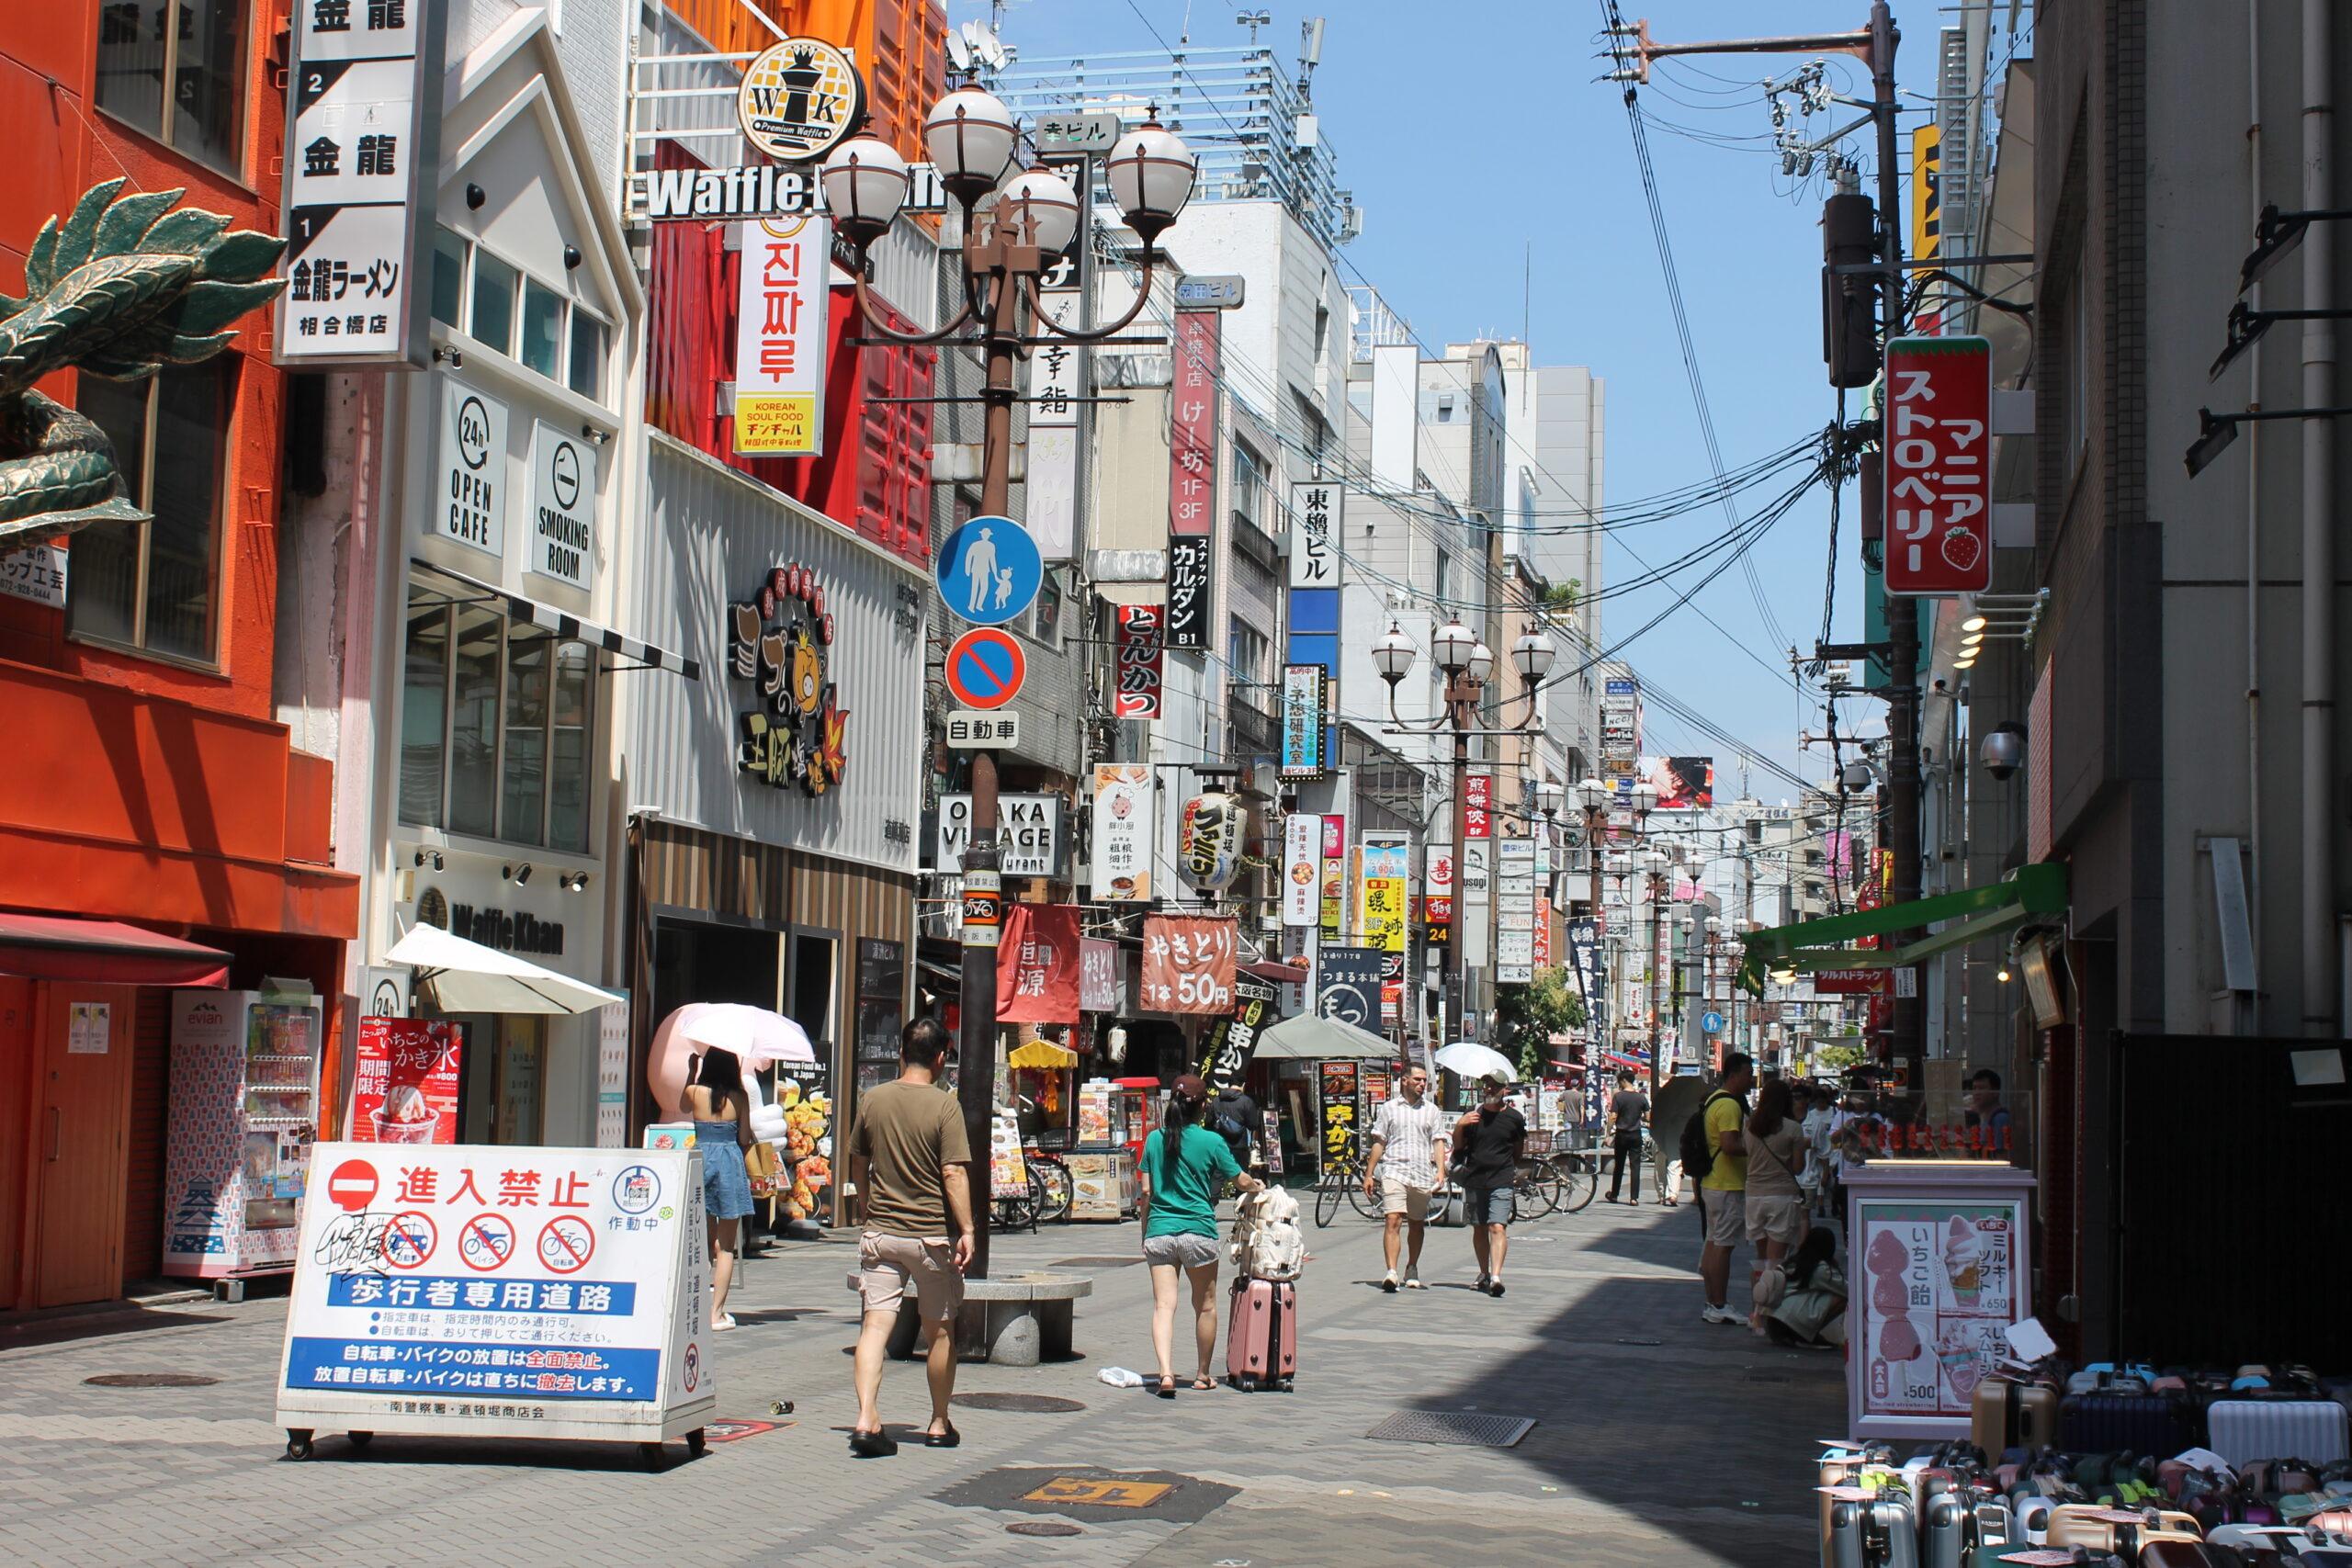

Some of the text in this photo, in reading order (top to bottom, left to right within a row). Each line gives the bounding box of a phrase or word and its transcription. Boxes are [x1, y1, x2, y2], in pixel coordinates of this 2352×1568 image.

[312, 0, 405, 32] 金龍
[308, 73, 322, 91] 2
[752, 87, 842, 123] W K
[761, 122, 824, 138] Premium Waffle
[304, 135, 397, 177] 金龍
[646, 165, 808, 217] Waffle
[300, 220, 311, 237] 1
[291, 258, 399, 301] 金龍ラーメン
[300, 314, 388, 336] 相合橋店
[759, 243, 803, 383] 진짜루
[747, 412, 804, 421] SOUL FOOD
[755, 402, 797, 411] KOREAN
[462, 416, 484, 448] 24h
[1181, 401, 1204, 471] けー坊
[1894, 371, 1983, 571] ストロベリー マニア
[451, 468, 492, 513] OPEN
[1182, 479, 1202, 495] 1F
[1179, 502, 1202, 519] 3F
[449, 503, 489, 546] CAFE
[538, 506, 589, 552] SMOKING
[548, 544, 580, 581] ROOM
[1198, 538, 1207, 585] スナック
[1171, 545, 1196, 629] カルダン
[1179, 634, 1195, 645] B1
[1120, 606, 1161, 716] とんかつ
[950, 719, 1015, 739] 自動車
[1289, 689, 1306, 765] 予想研究室
[950, 801, 1045, 822] OAKA
[1296, 888, 1306, 916] 麻辣烫
[1148, 926, 1232, 967] やきとり
[1819, 970, 1881, 980] ツルハドラッグ
[1148, 973, 1228, 1005] 1本 50円
[188, 1012, 222, 1025] evian
[362, 1027, 387, 1038] たっぷり
[379, 1032, 429, 1049] いちごの
[395, 1037, 458, 1071] かき氷
[783, 1061, 801, 1069] Korean
[802, 1062, 814, 1070] Food
[359, 1059, 391, 1078] 期間
[800, 1071, 815, 1080] Japan
[357, 1077, 390, 1096] 限定
[395, 1166, 590, 1208] 進入禁止
[608, 1216, 658, 1232] 作動中
[1980, 1221, 2006, 1229] いちご
[473, 1255, 495, 1264] バイク
[553, 1258, 574, 1267] 自転車
[1911, 1227, 1930, 1306] いちご飴
[1993, 1235, 2006, 1293] ミルキー
[352, 1279, 612, 1312] 歩行者専用道路
[383, 1312, 576, 1328] 指定車は、指定時間内のみ通行可。
[381, 1325, 612, 1343] 自転車は、おりて押してご通行ください。
[344, 1344, 611, 1370] 自転車・バイクの放置は全面禁止。
[314, 1366, 634, 1393] 放置自転車・バイクは直ちに撤去します。
[1904, 1385, 1936, 1399] ¥500
[390, 1401, 545, 1418] 南警察署・道頓堀商店会
